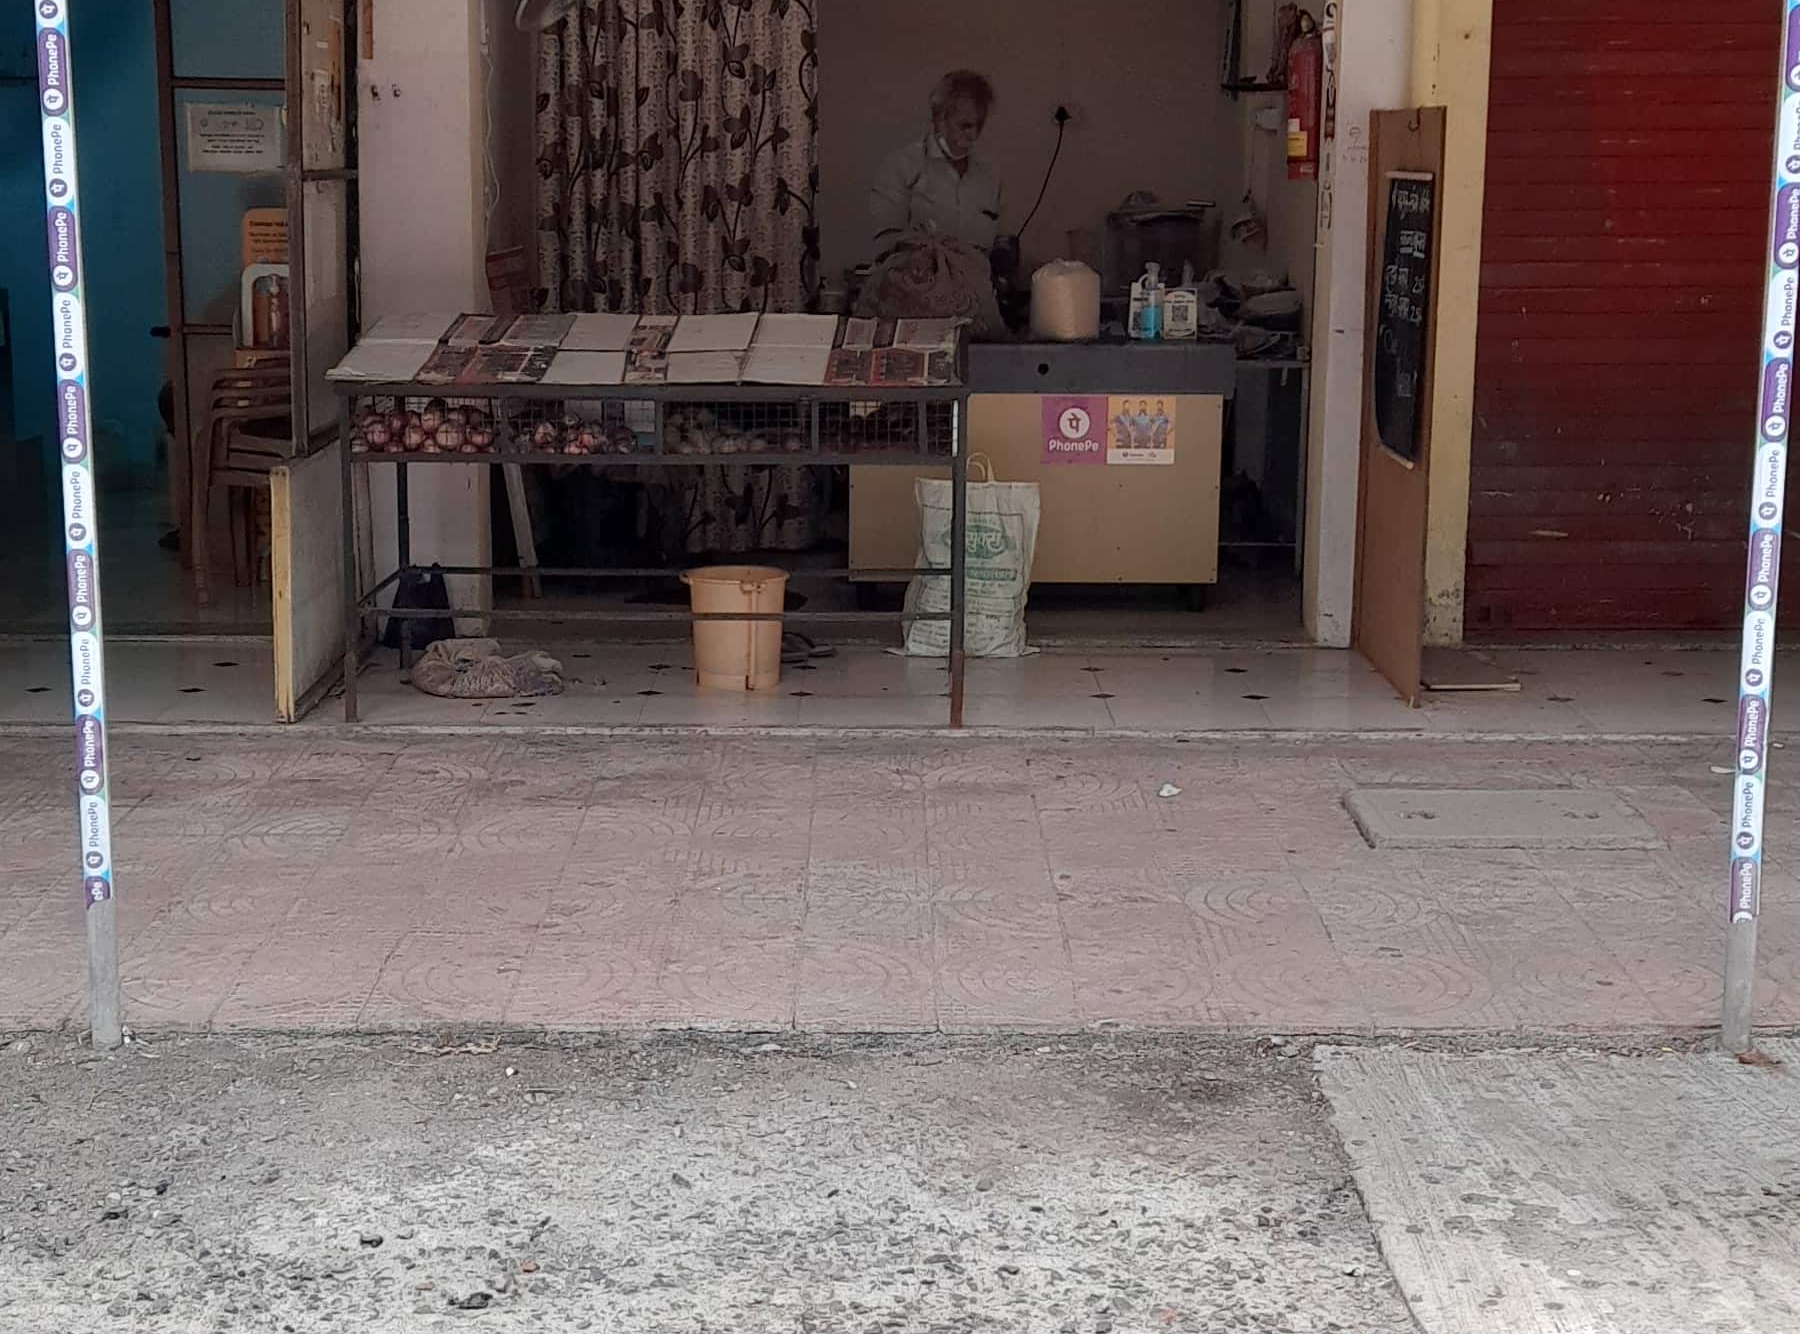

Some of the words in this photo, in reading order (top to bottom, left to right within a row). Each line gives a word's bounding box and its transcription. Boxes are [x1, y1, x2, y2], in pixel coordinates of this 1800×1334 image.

[47, 34, 60, 86] PhonePe
[51, 124, 64, 175] PhonePe
[56, 212, 68, 263] PhonePe
[61, 299, 73, 349] PhonePe
[1781, 277, 1796, 327] PhonePe
[65, 385, 79, 435] PhonePe
[1774, 363, 1789, 413] PhonePe
[1048, 440, 1100, 452] PhonePe
[70, 471, 82, 519] PhonePe
[1766, 450, 1780, 498] PhonePe
[75, 554, 89, 604] PhonePe
[1758, 533, 1774, 583] PhonePe
[79, 638, 91, 685] PhonePe
[1752, 618, 1766, 665] PhonePe
[83, 720, 96, 768] PhonePe
[1744, 700, 1760, 748] PhonePe
[88, 801, 99, 847] PhonePe
[1741, 781, 1755, 828] PhonePe
[1739, 862, 1753, 909] PhonePe
